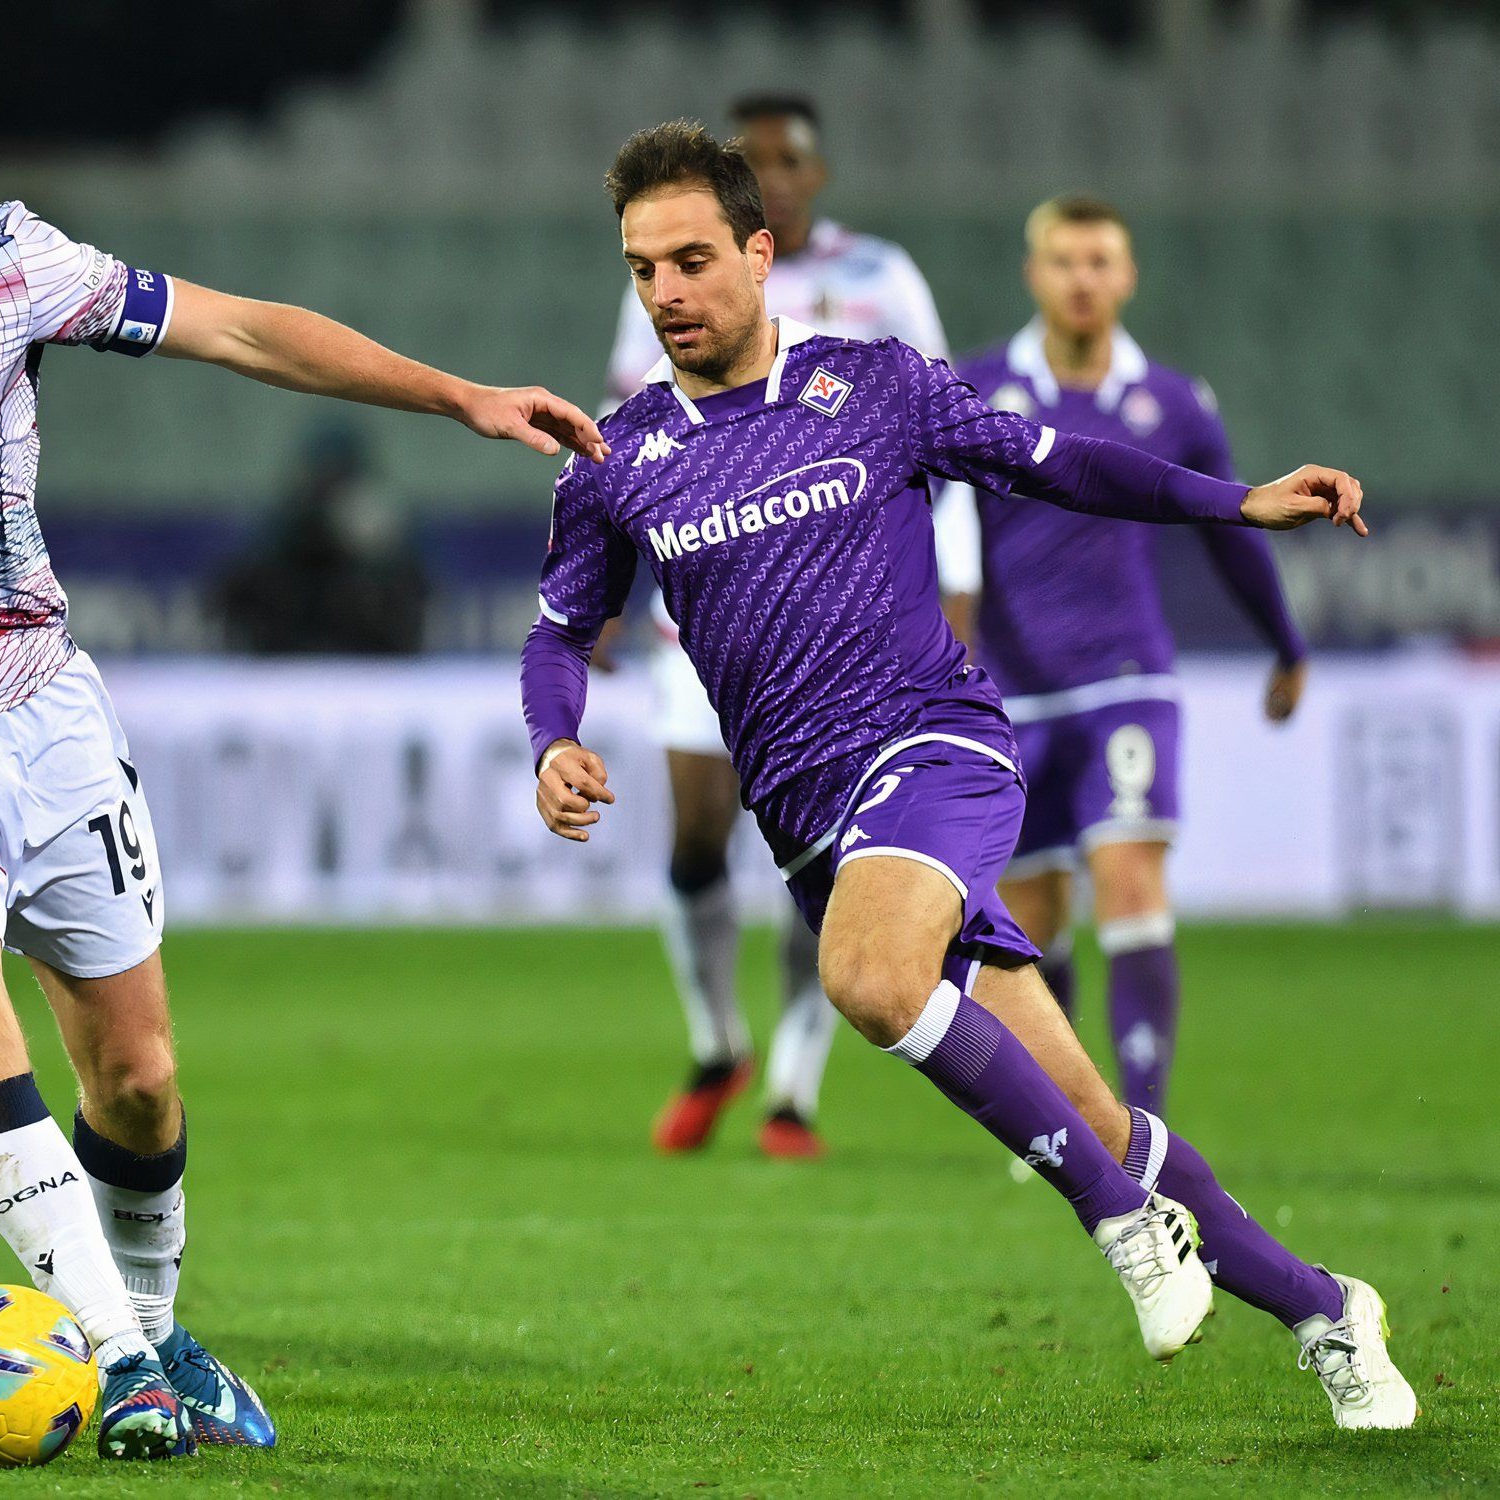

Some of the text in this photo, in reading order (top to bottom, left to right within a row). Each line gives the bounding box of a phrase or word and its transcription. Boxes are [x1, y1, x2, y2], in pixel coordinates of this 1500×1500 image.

[648, 478, 851, 562] Mediacom
[1104, 723, 1156, 799] 9
[88, 800, 146, 896] 19
